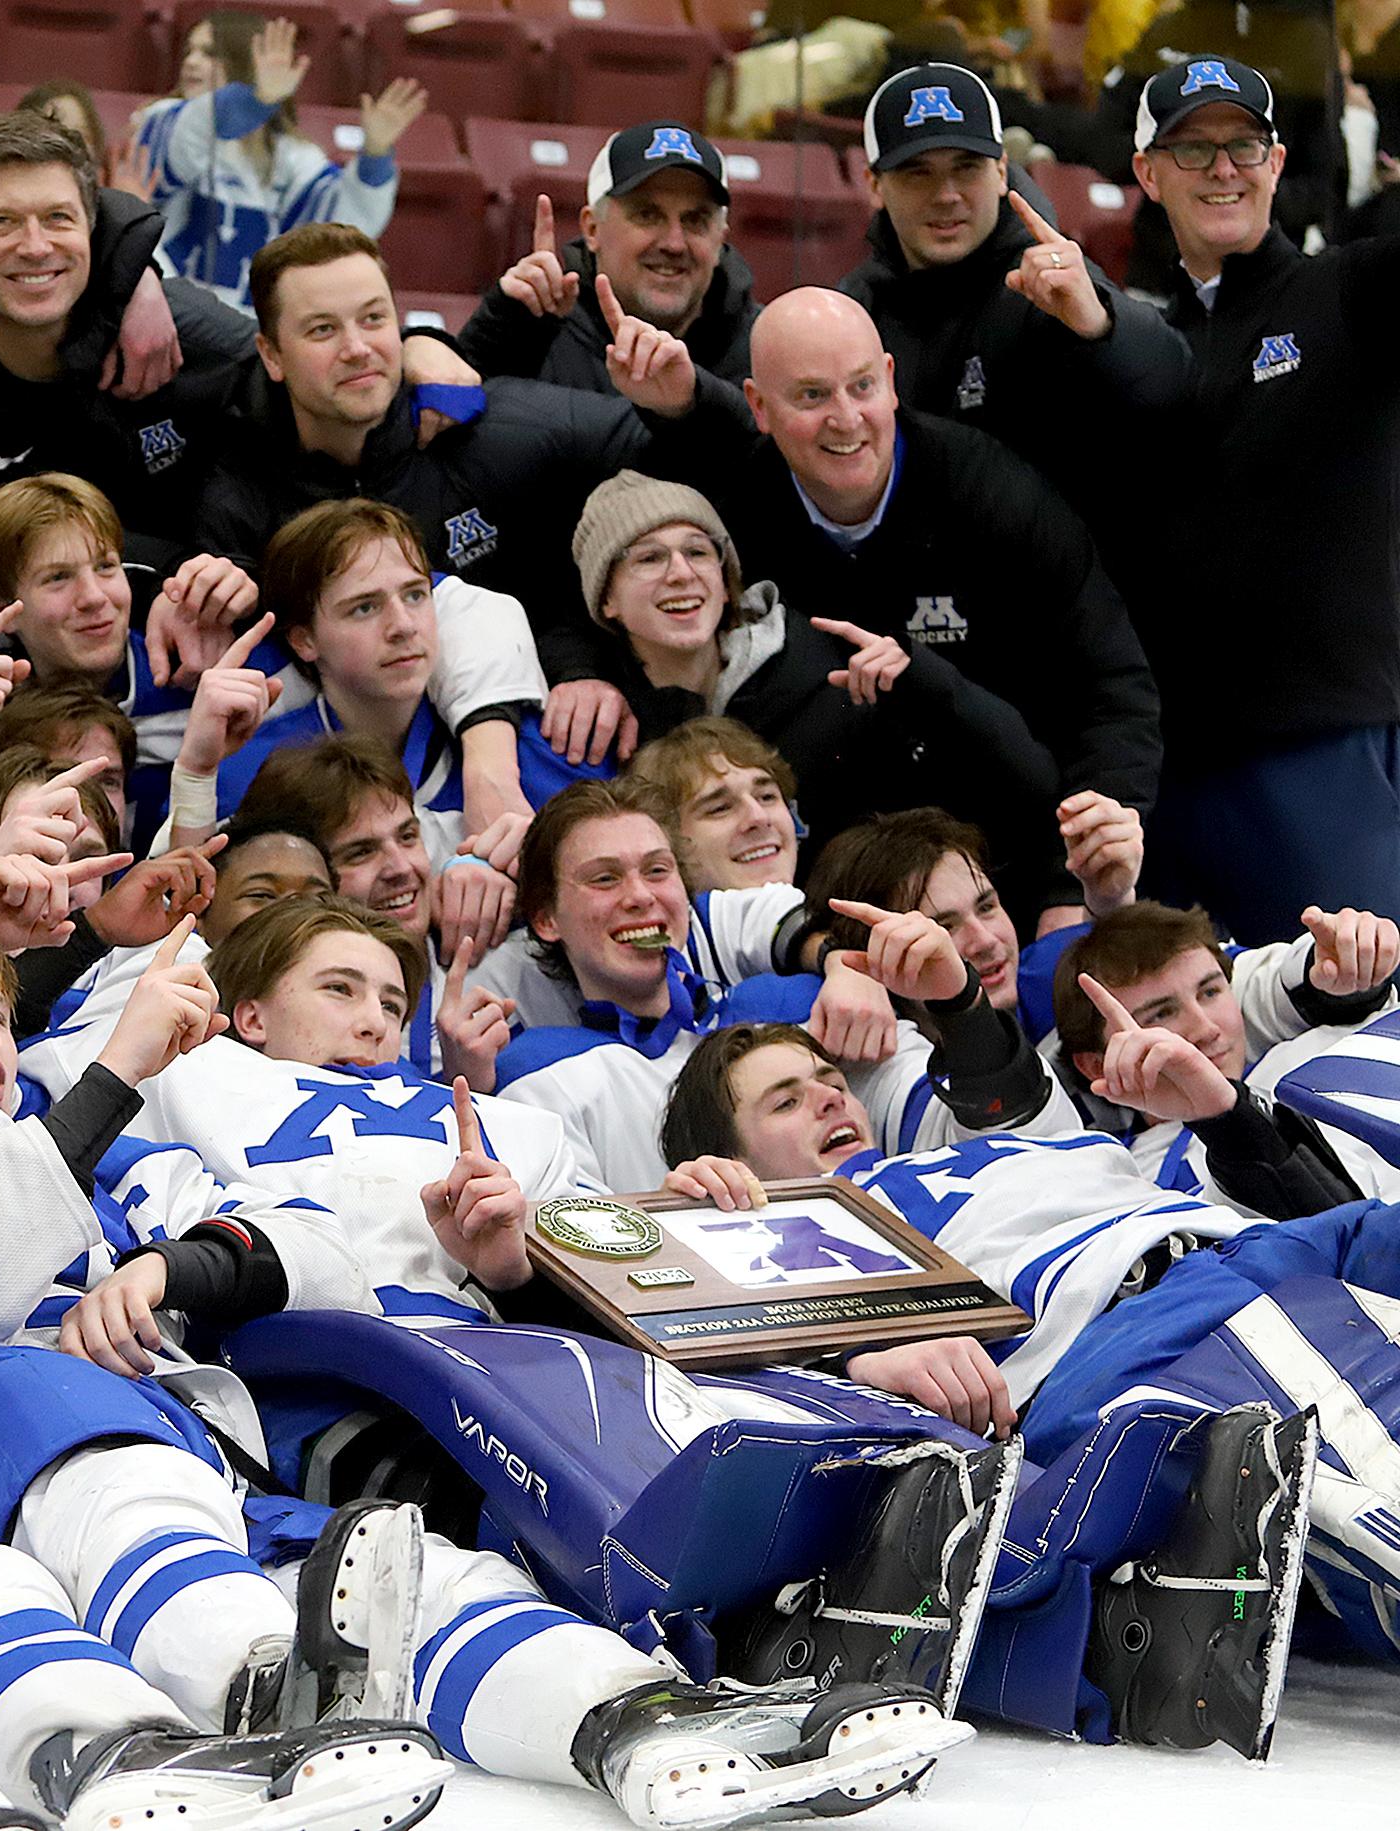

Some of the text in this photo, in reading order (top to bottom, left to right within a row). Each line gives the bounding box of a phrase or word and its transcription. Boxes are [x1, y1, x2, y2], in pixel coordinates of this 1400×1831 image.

[1179, 61, 1241, 97] M
[903, 86, 965, 128] M
[643, 127, 704, 163] M
[1252, 332, 1301, 371] M
[444, 506, 499, 559] M
[905, 595, 968, 631] M
[663, 1319, 732, 1335] SECTION
[733, 1317, 764, 1329] 2AA
[762, 1308, 843, 1326] CHAMPION
[856, 1302, 904, 1316] STATE
[903, 1295, 985, 1312] QUALIFIER
[763, 1296, 867, 1316] BOYS HOCKEY
[450, 1395, 551, 1519] VAPOR
